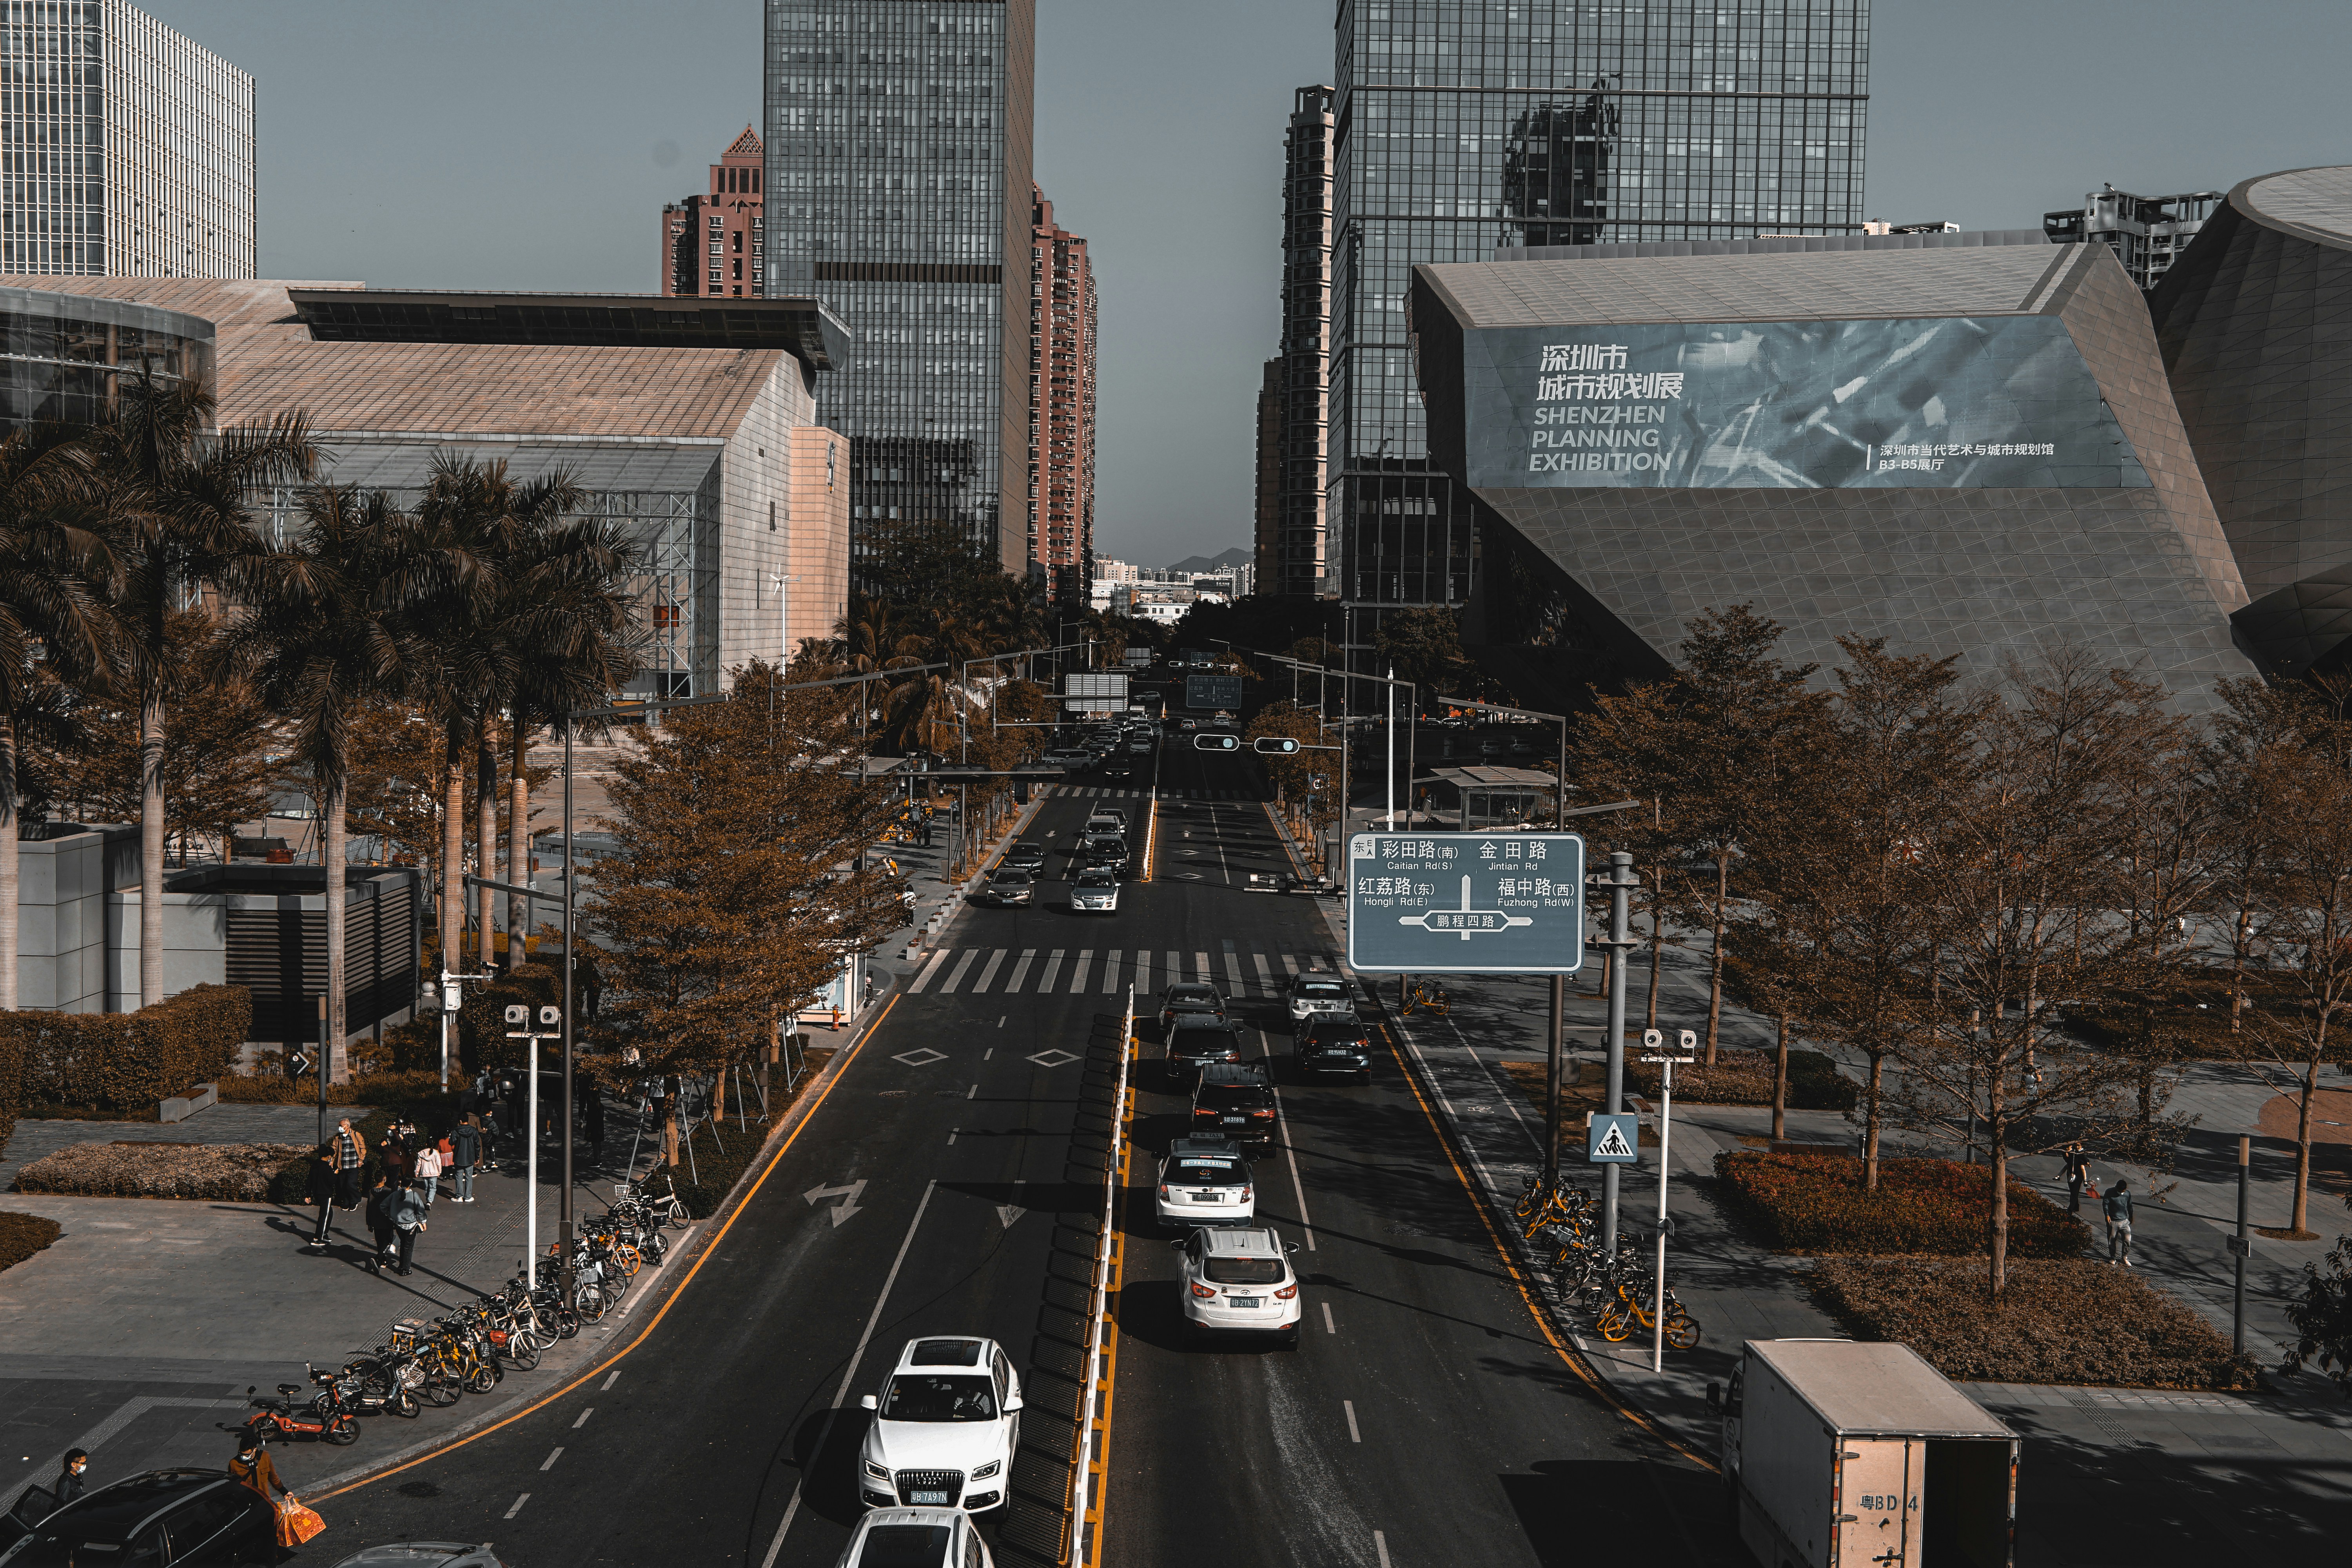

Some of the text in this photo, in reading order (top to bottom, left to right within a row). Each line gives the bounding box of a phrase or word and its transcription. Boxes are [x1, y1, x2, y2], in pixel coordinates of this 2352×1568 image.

[1540, 344, 1628, 371] 深圳市
[1536, 372, 1684, 401] 城市规划展
[1534, 406, 1665, 425] SHENZHEN
[1532, 429, 1659, 448] PLANNING
[1880, 443, 2054, 457] 深圳市当代艺术与城市规划馆
[1529, 453, 1671, 471] EXHIBITION
[1879, 459, 1945, 471] B3-B5展厅
[1354, 842, 1365, 853] 东
[1387, 862, 1419, 870] Caitian
[1365, 897, 1428, 907] Hongli Rd(E)
[1498, 898, 1573, 908] Fuzhong Rd(W)
[1437, 915, 1494, 927] 鹏程四路
